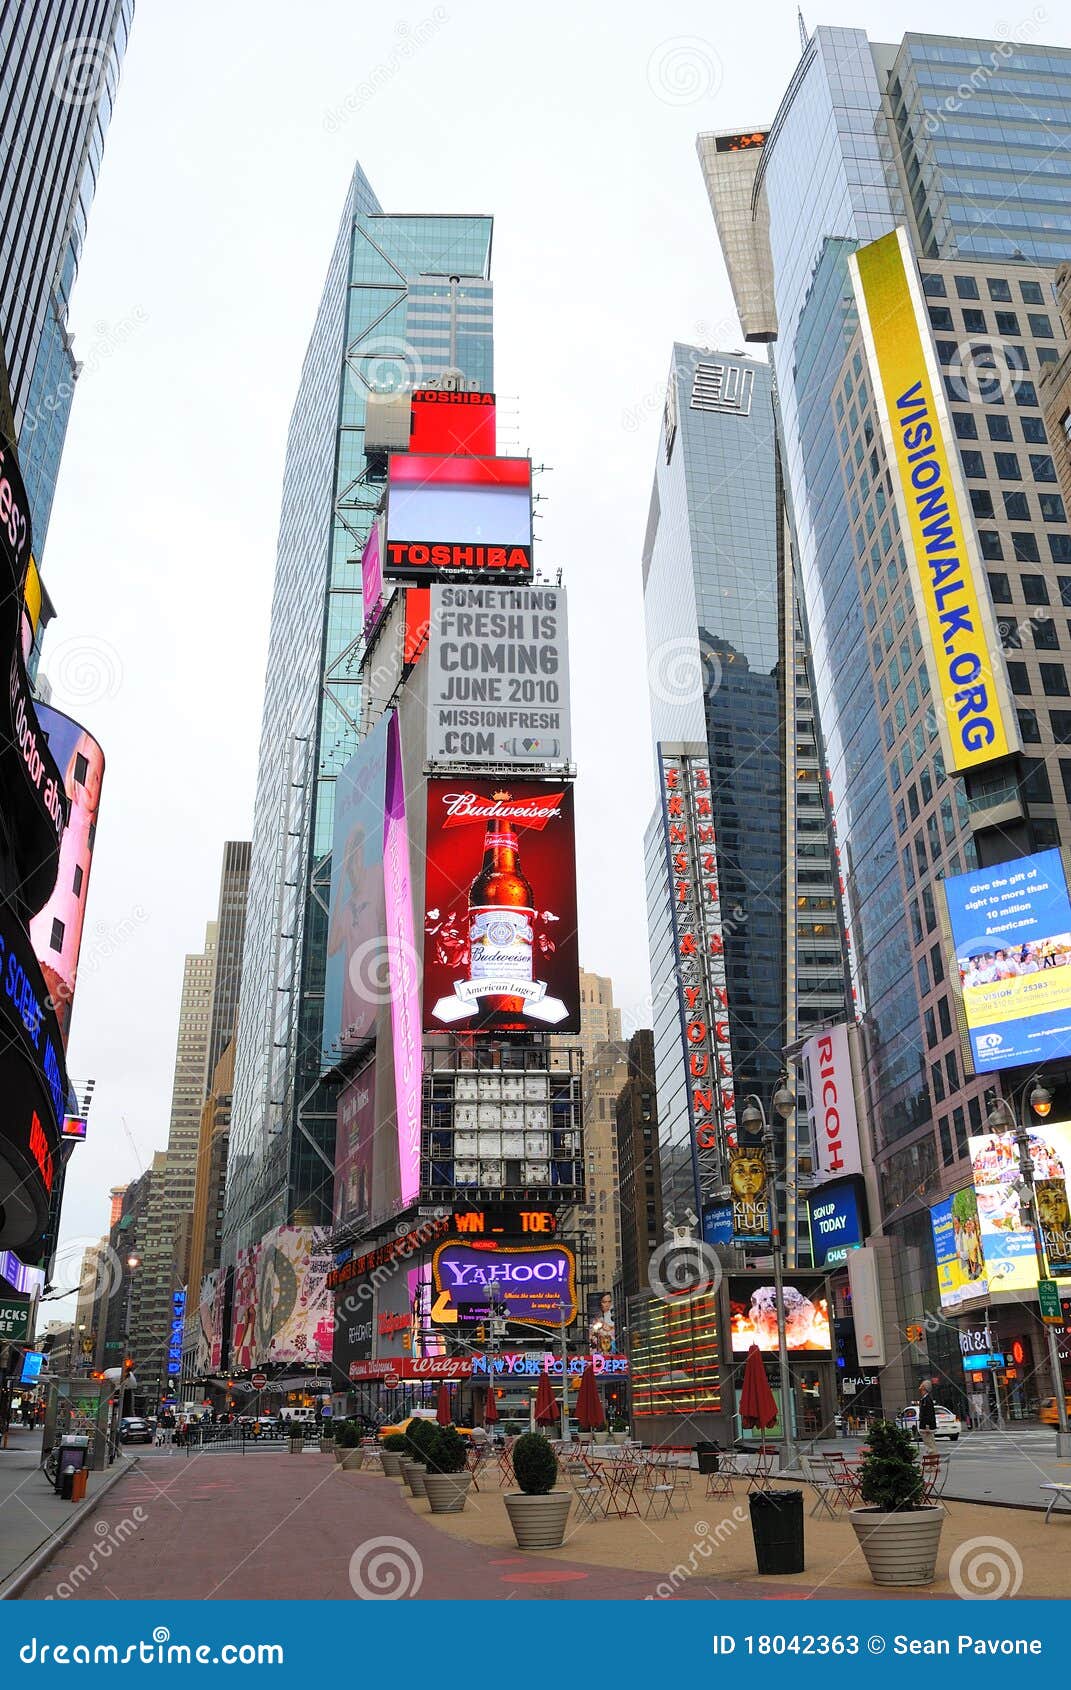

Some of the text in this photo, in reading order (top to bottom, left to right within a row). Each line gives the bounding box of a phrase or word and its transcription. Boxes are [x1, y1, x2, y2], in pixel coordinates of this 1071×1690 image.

[414, 391, 494, 404] TOSHIBA
[388, 544, 529, 568] TOSHIBA
[896, 380, 996, 753] VISIONWALK.ORG
[441, 588, 557, 611] SOMETHING
[440, 612, 557, 640] FRESH IS
[440, 642, 559, 675] COMING
[440, 677, 560, 703] JUNE 2010
[439, 710, 560, 729] MISSIONFRESH
[439, 731, 495, 755] .COM
[442, 793, 561, 817] Budweiser
[970, 869, 1037, 894] Give the gift of
[965, 883, 1049, 910] sight to more than
[986, 903, 1032, 919] 10 million
[985, 917, 1038, 935] Americans.
[472, 947, 531, 962] Budweiser
[667, 768, 715, 1149] ERNST & YOUNG
[466, 983, 537, 996] American Lager
[983, 989, 1012, 1001] VISION
[817, 1035, 844, 1170] RICOH
[733, 1202, 766, 1214] KING
[826, 1203, 835, 1216] UP
[454, 1212, 485, 1232] WIN
[733, 1214, 766, 1229] TUT
[819, 1215, 847, 1234] TODAY
[827, 1248, 848, 1262] CHAS
[442, 1260, 566, 1286] YAHOO!
[504, 1355, 541, 1374] YORK
[592, 1353, 628, 1374] DEPT
[842, 1376, 878, 1385] CHASE
